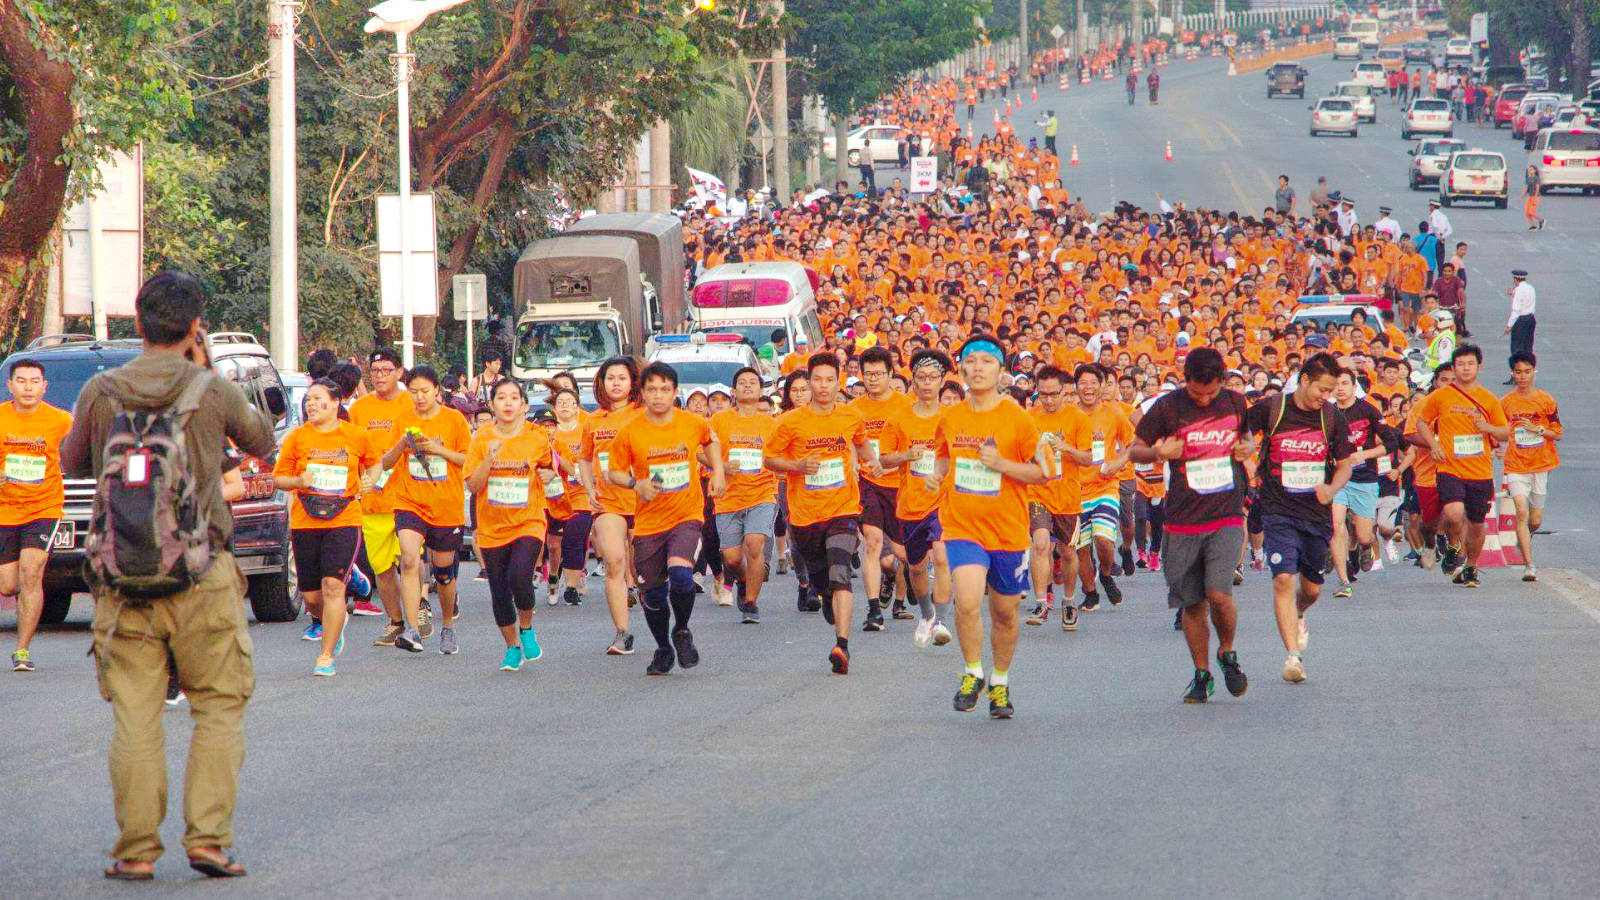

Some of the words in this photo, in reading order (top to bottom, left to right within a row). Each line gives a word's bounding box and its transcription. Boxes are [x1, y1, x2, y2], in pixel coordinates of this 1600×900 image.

[807, 437, 837, 447] YANGON
[1187, 431, 1225, 444] RUN
[1281, 438, 1317, 451] RUN
